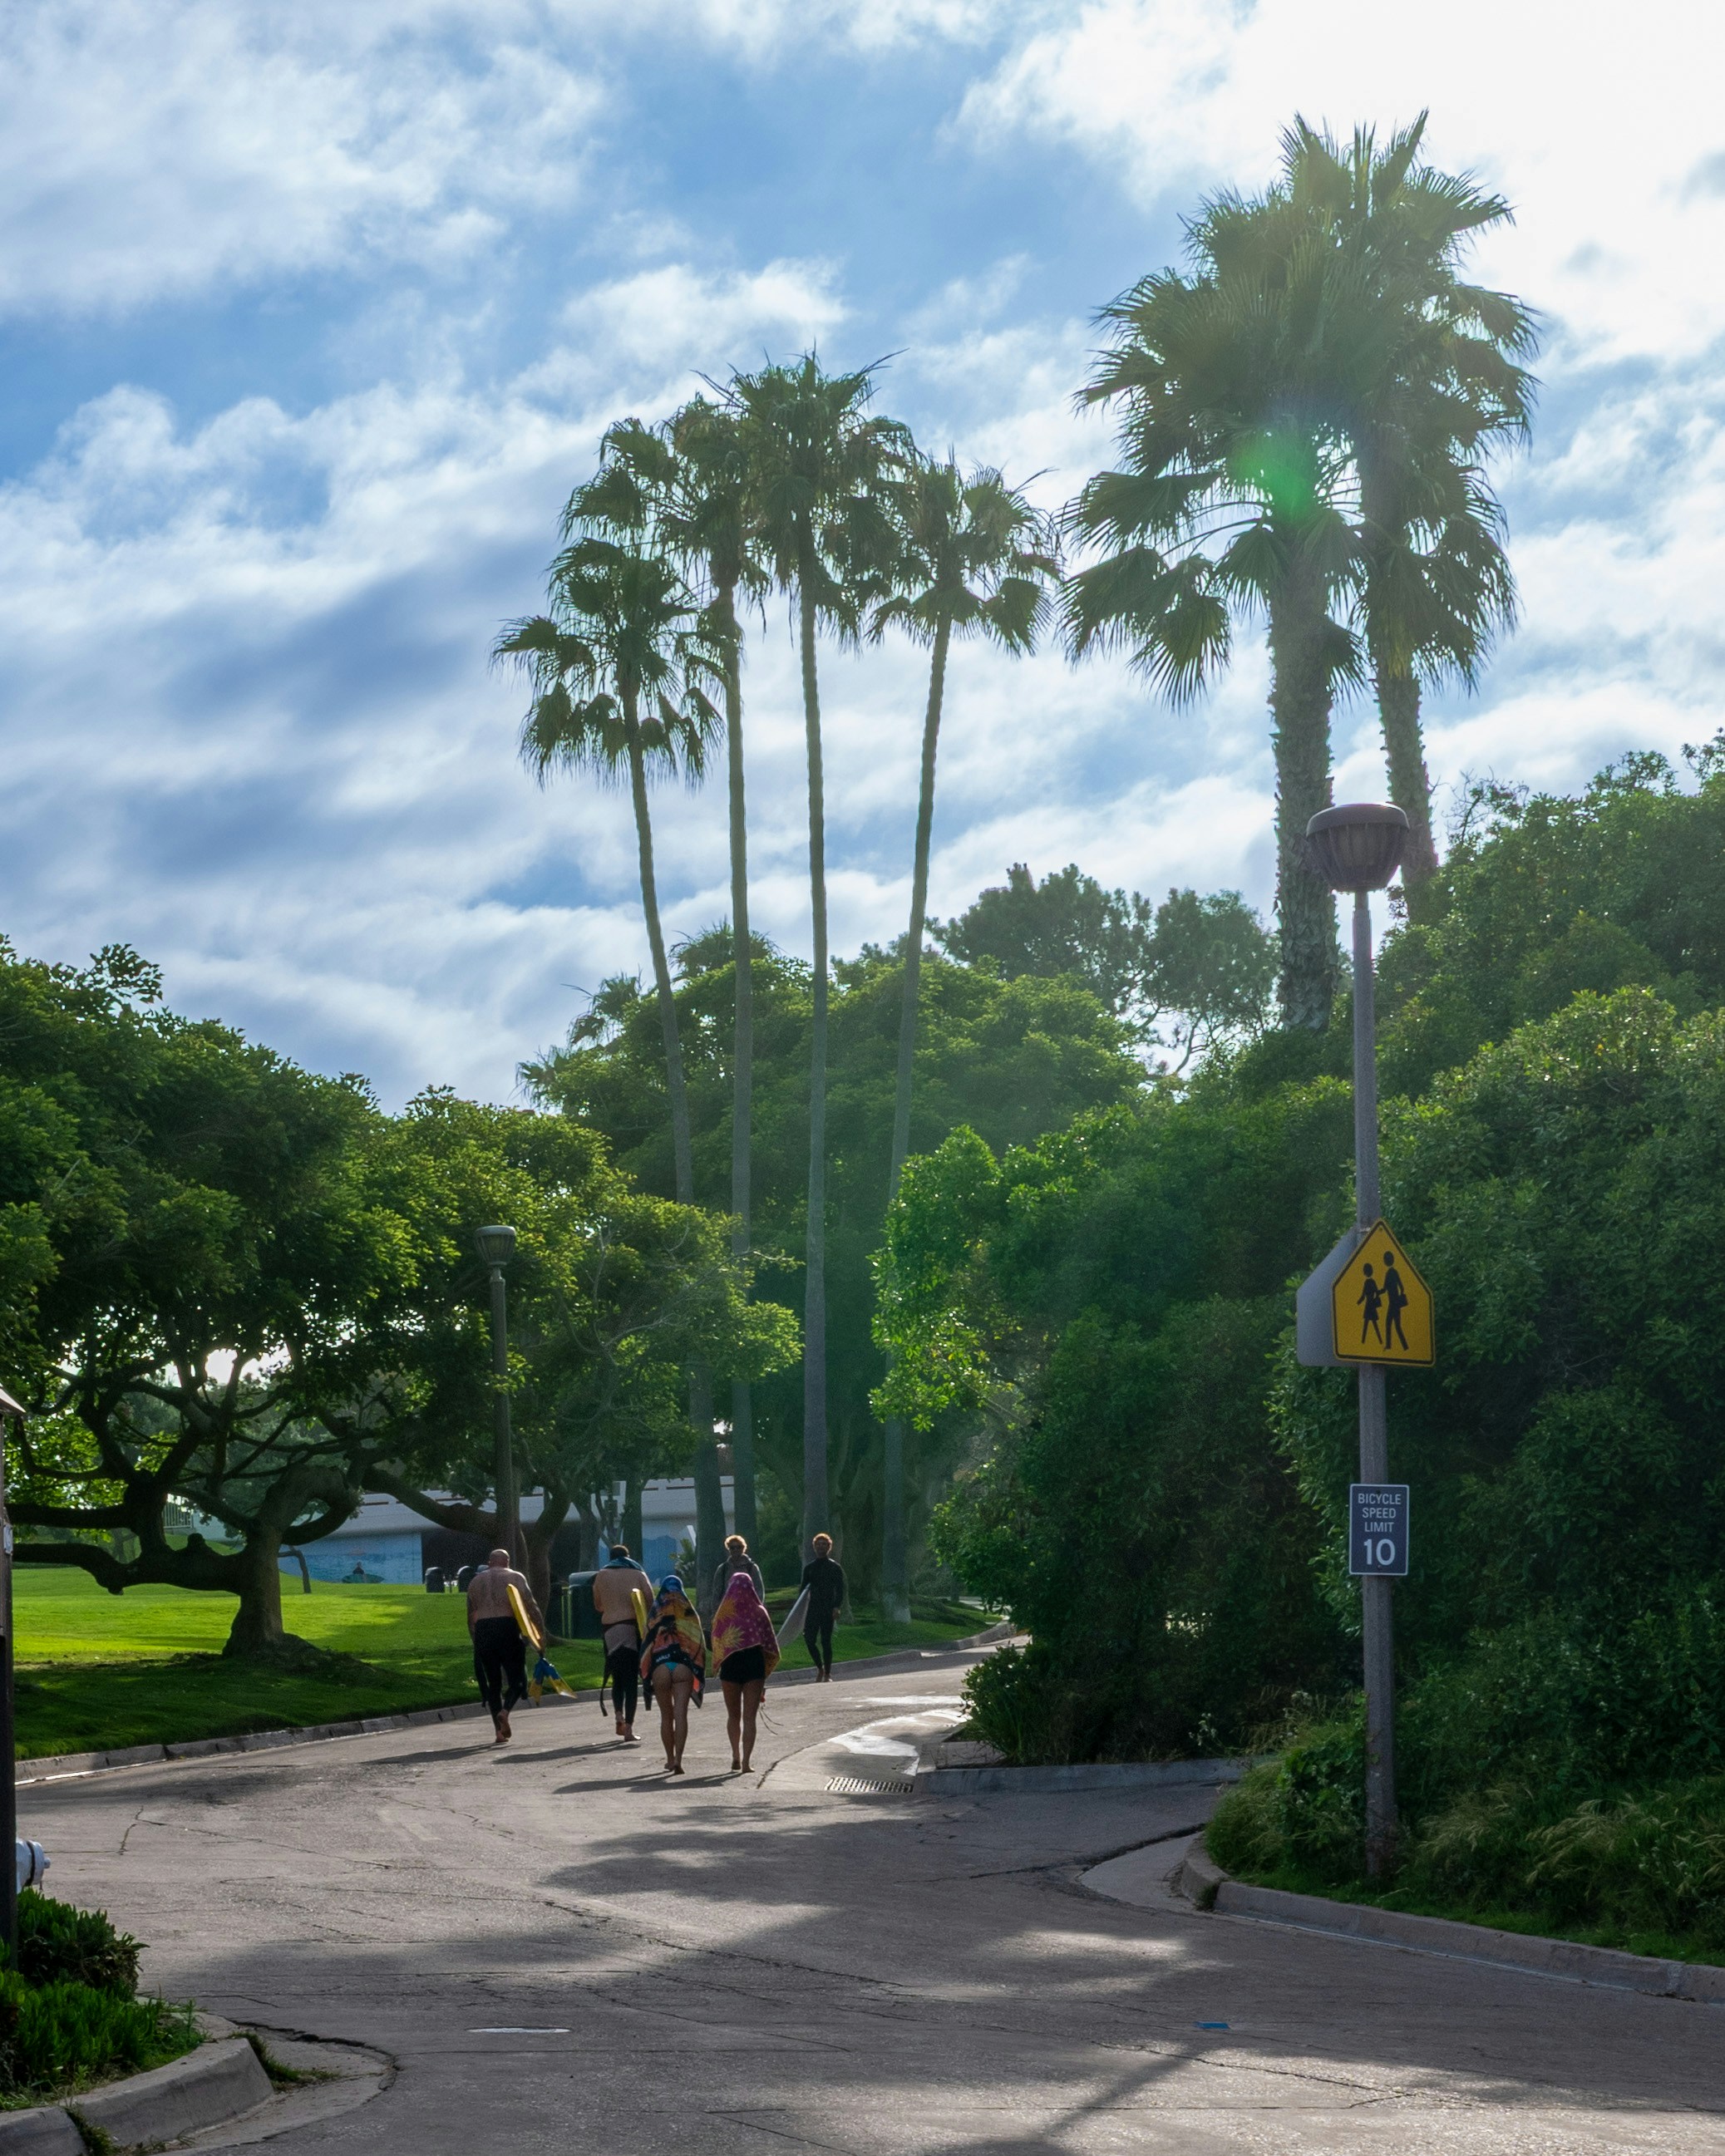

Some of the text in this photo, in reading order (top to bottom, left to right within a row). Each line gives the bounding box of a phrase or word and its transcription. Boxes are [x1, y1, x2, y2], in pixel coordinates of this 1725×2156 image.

[1358, 1493, 1402, 1505] BICYCLE
[1362, 1508, 1397, 1519] SPEED
[1364, 1522, 1394, 1533] LIMIT
[1363, 1538, 1396, 1566] 10
